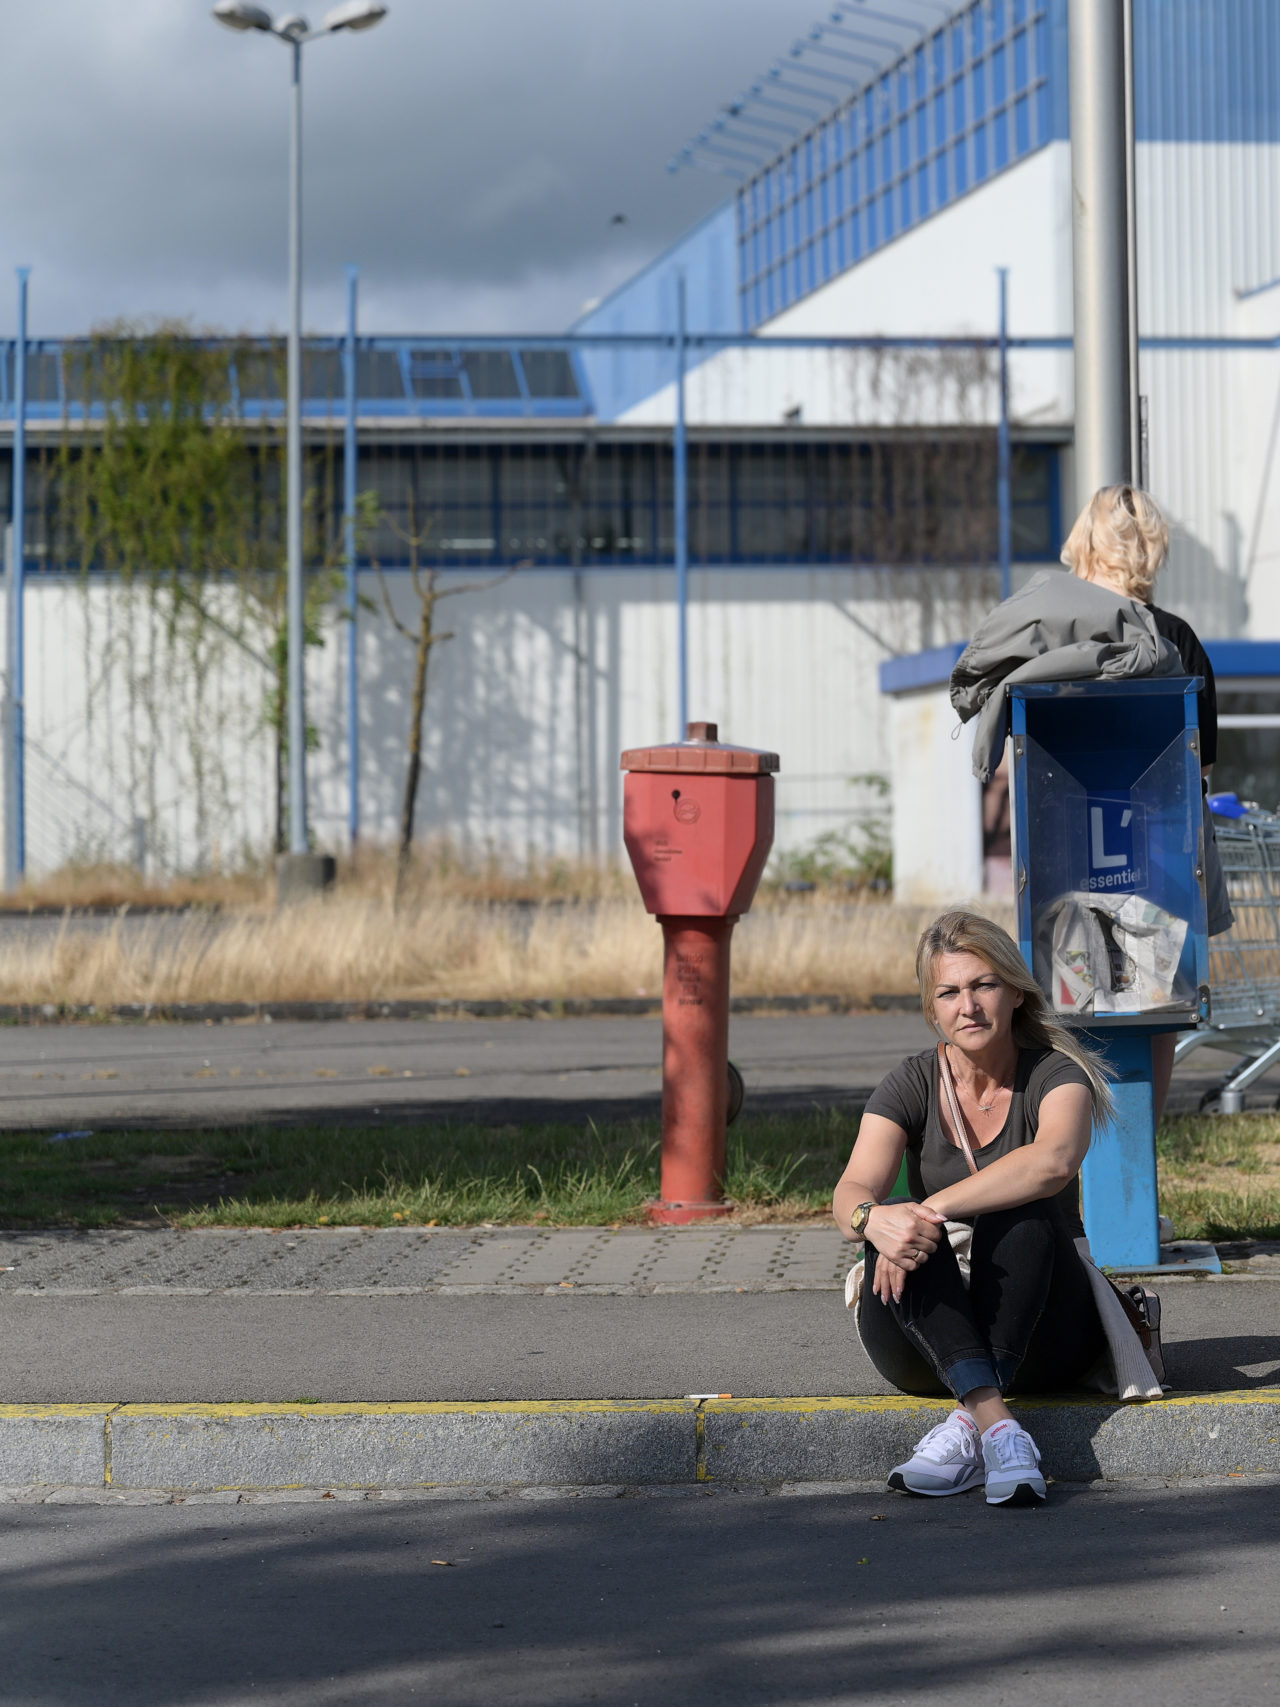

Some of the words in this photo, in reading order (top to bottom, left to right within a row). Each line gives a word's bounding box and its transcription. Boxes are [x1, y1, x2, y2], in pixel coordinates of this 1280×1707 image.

[1091, 807, 1132, 868] L'
[1080, 868, 1141, 890] essentiel
[957, 1415, 974, 1430] Reebok
[990, 1424, 1007, 1438] Reebok
